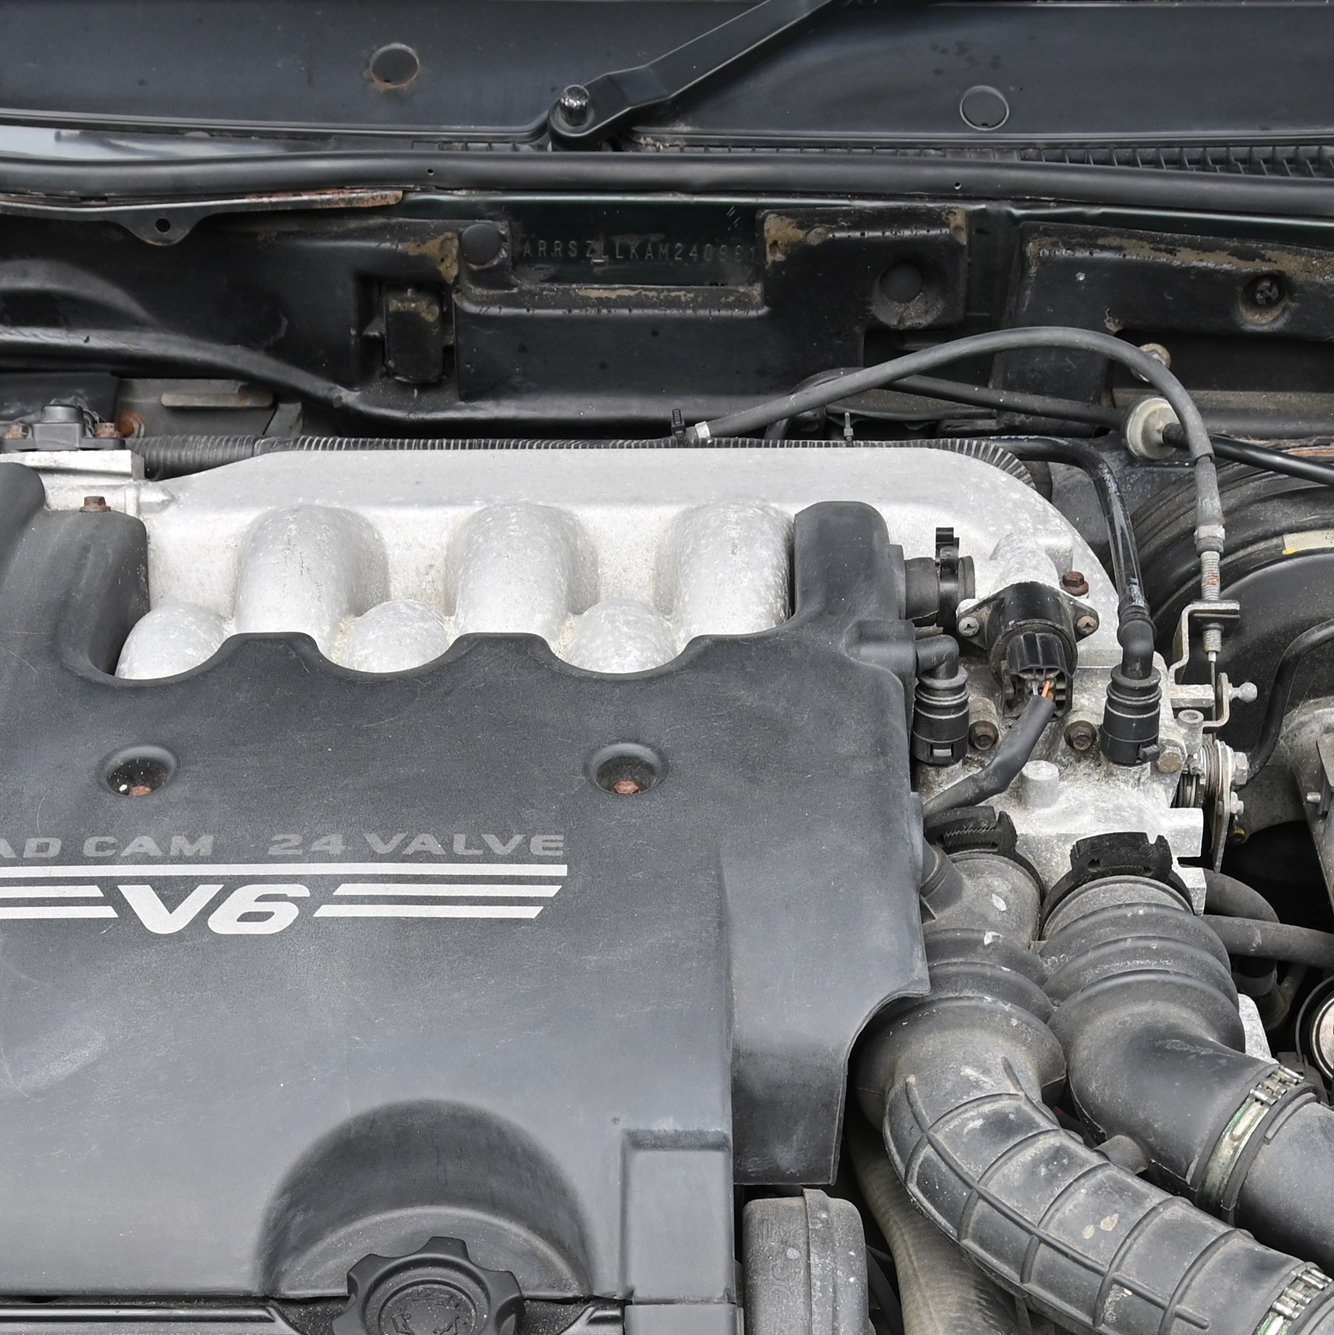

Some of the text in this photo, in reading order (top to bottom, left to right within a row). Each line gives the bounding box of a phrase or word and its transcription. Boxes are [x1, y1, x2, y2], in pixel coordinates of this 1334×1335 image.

[84, 834, 214, 858] CAM
[266, 834, 347, 857] 24
[369, 833, 564, 857] VALVE
[118, 884, 310, 934] V6
